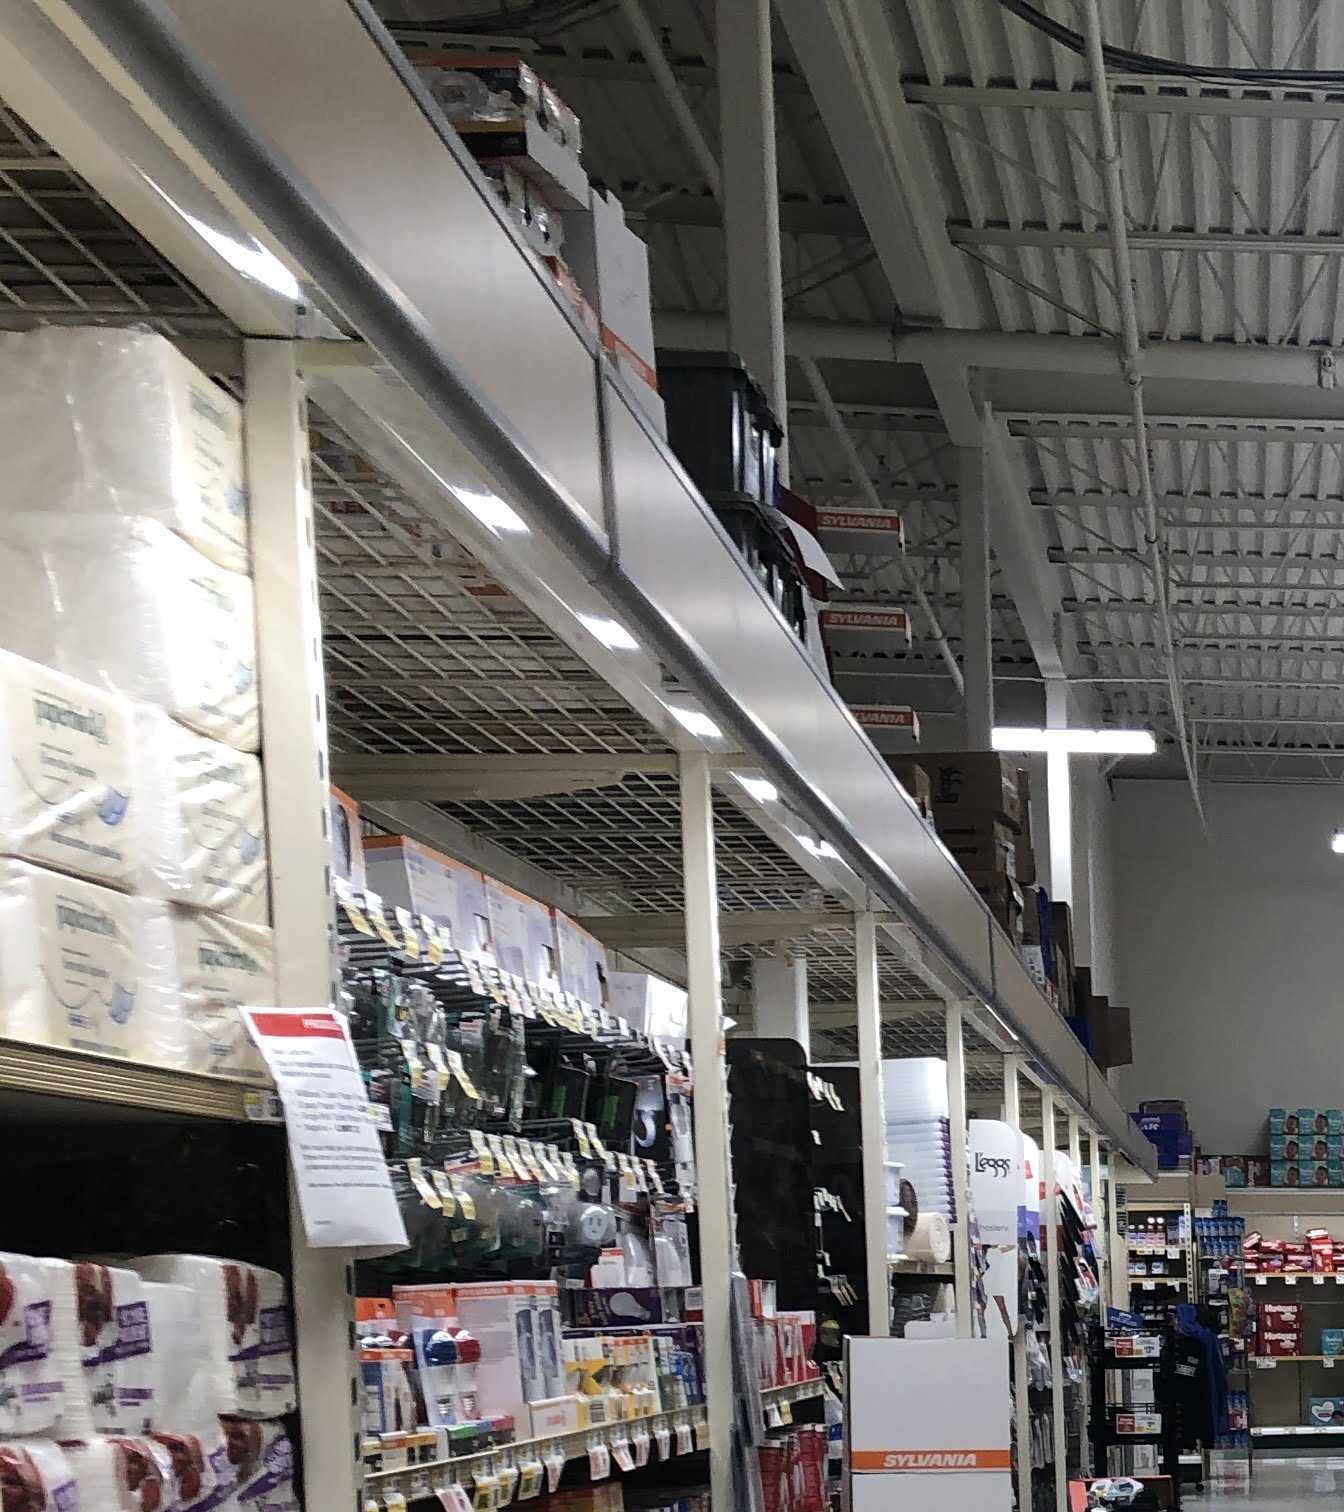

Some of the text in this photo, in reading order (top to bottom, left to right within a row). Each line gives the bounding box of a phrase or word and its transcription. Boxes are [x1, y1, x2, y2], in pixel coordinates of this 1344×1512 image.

[821, 514, 893, 529] SYLVANIA
[828, 612, 899, 626] SYLVANIA
[860, 711, 905, 724] LVANIA
[883, 1452, 977, 1469] SYLVANIA
